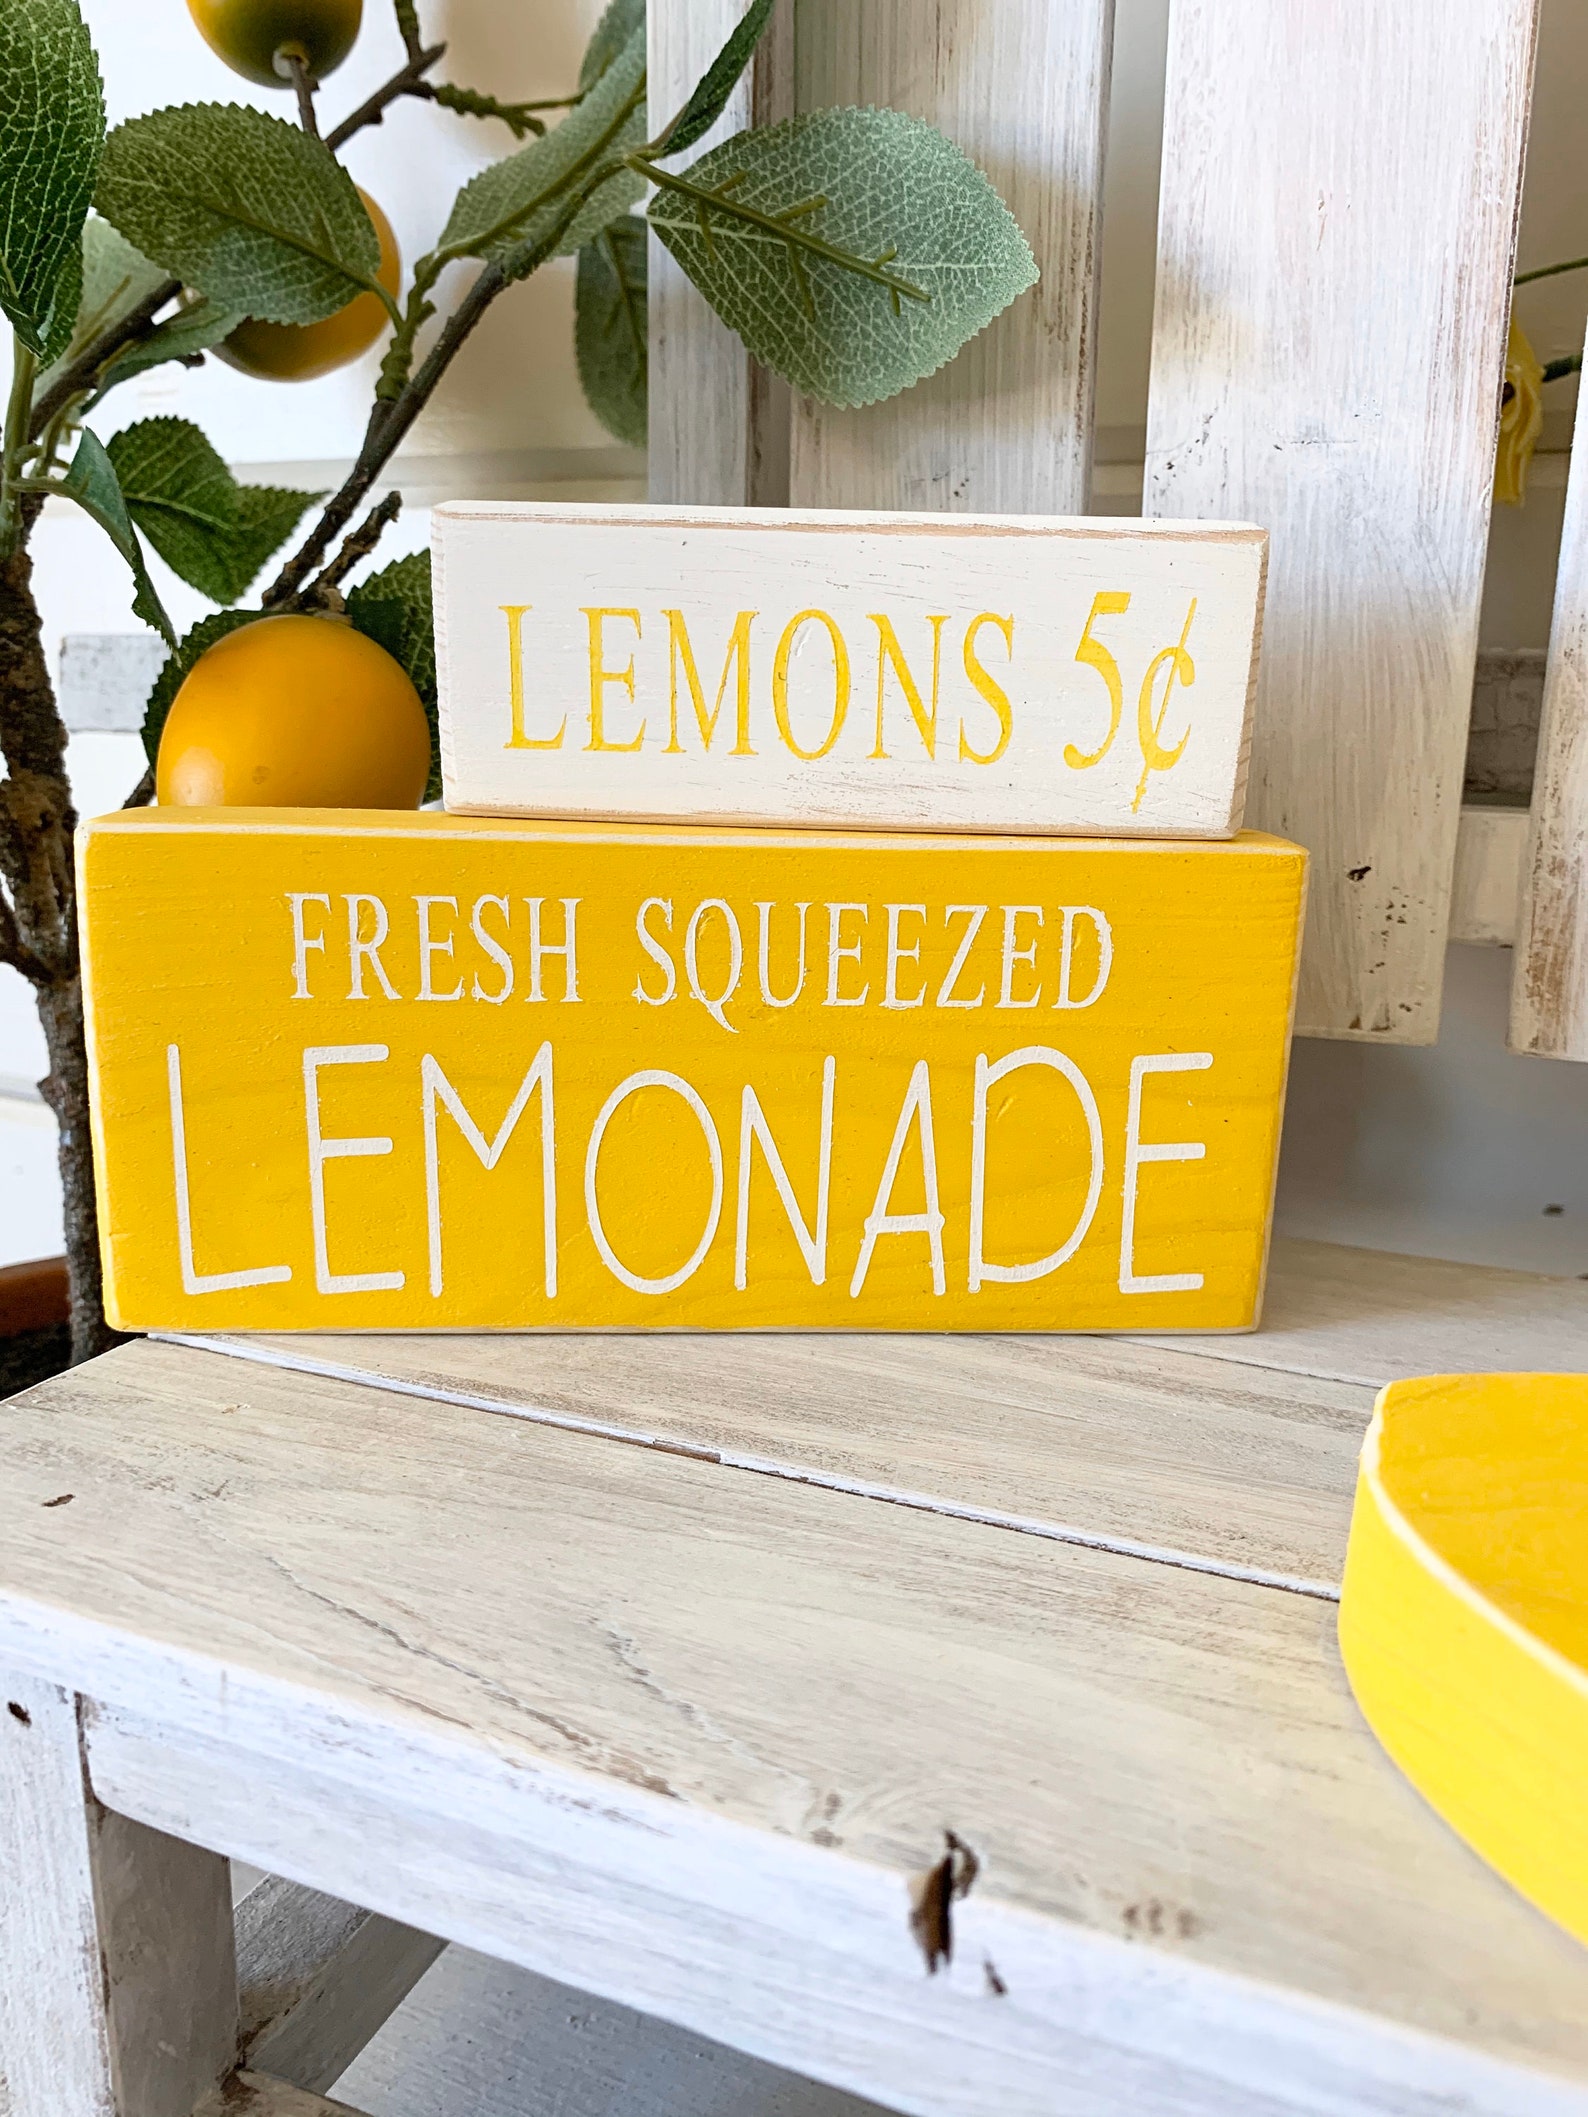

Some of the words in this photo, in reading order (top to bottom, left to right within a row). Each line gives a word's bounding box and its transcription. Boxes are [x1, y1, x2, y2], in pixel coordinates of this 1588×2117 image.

[497, 603, 1015, 765] LEMONS
[1063, 591, 1197, 813] 5¢
[284, 891, 582, 1006] FRESH
[631, 895, 1114, 1033] SQUEEZED
[166, 1040, 1214, 1299] LEMONADE
